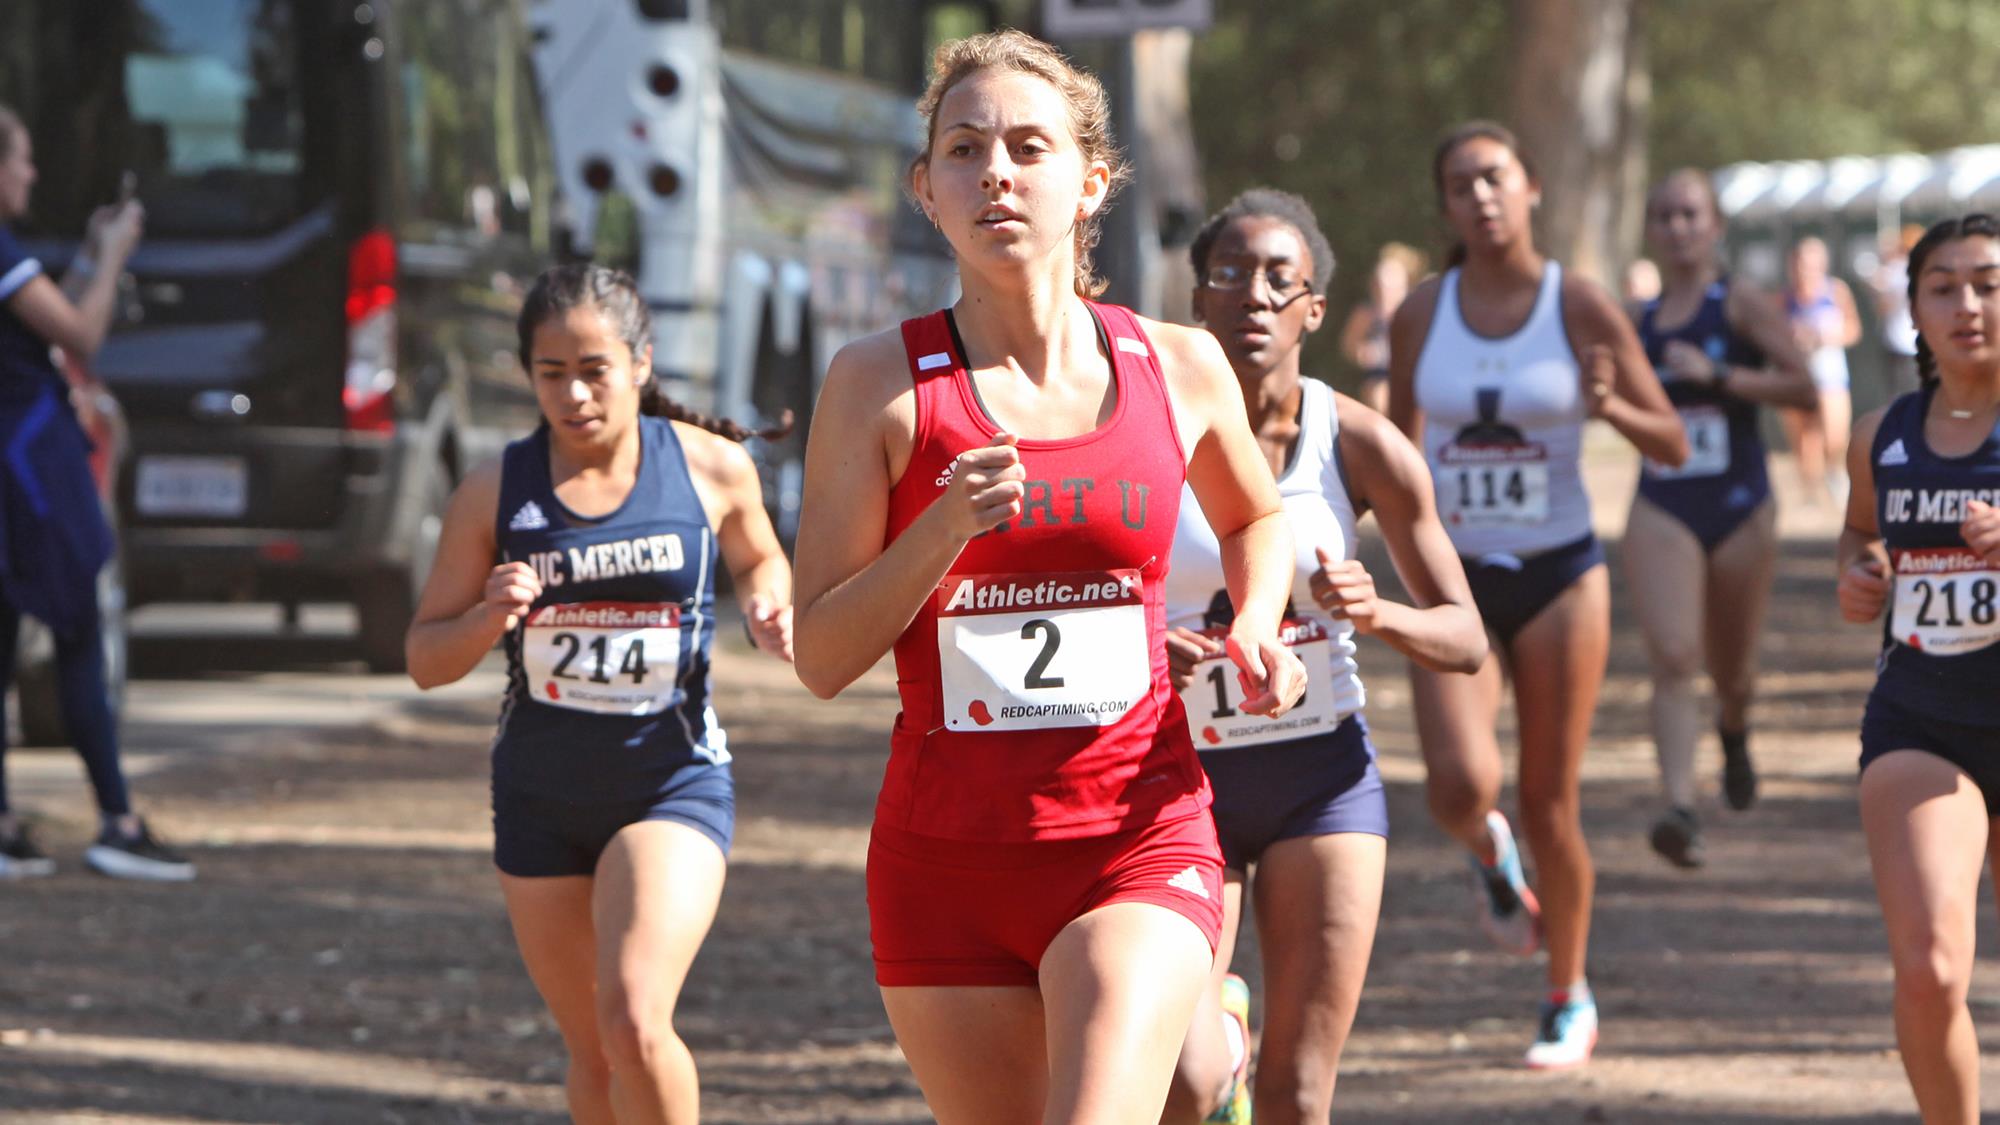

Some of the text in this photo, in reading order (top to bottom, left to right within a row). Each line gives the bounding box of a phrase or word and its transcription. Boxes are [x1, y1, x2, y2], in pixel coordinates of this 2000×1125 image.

[975, 477, 1150, 538] RT U
[1458, 469, 1525, 507] 114
[1885, 488, 2000, 523] UC MER
[529, 533, 685, 587] UC MERCED
[533, 605, 672, 627] Athletic.net
[944, 577, 1132, 612] Athletic.net
[1912, 578, 1996, 628] 218
[551, 631, 649, 685] 214
[1020, 618, 1065, 690] 2
[1001, 700, 1129, 719] REDCAPTIMING.COM
